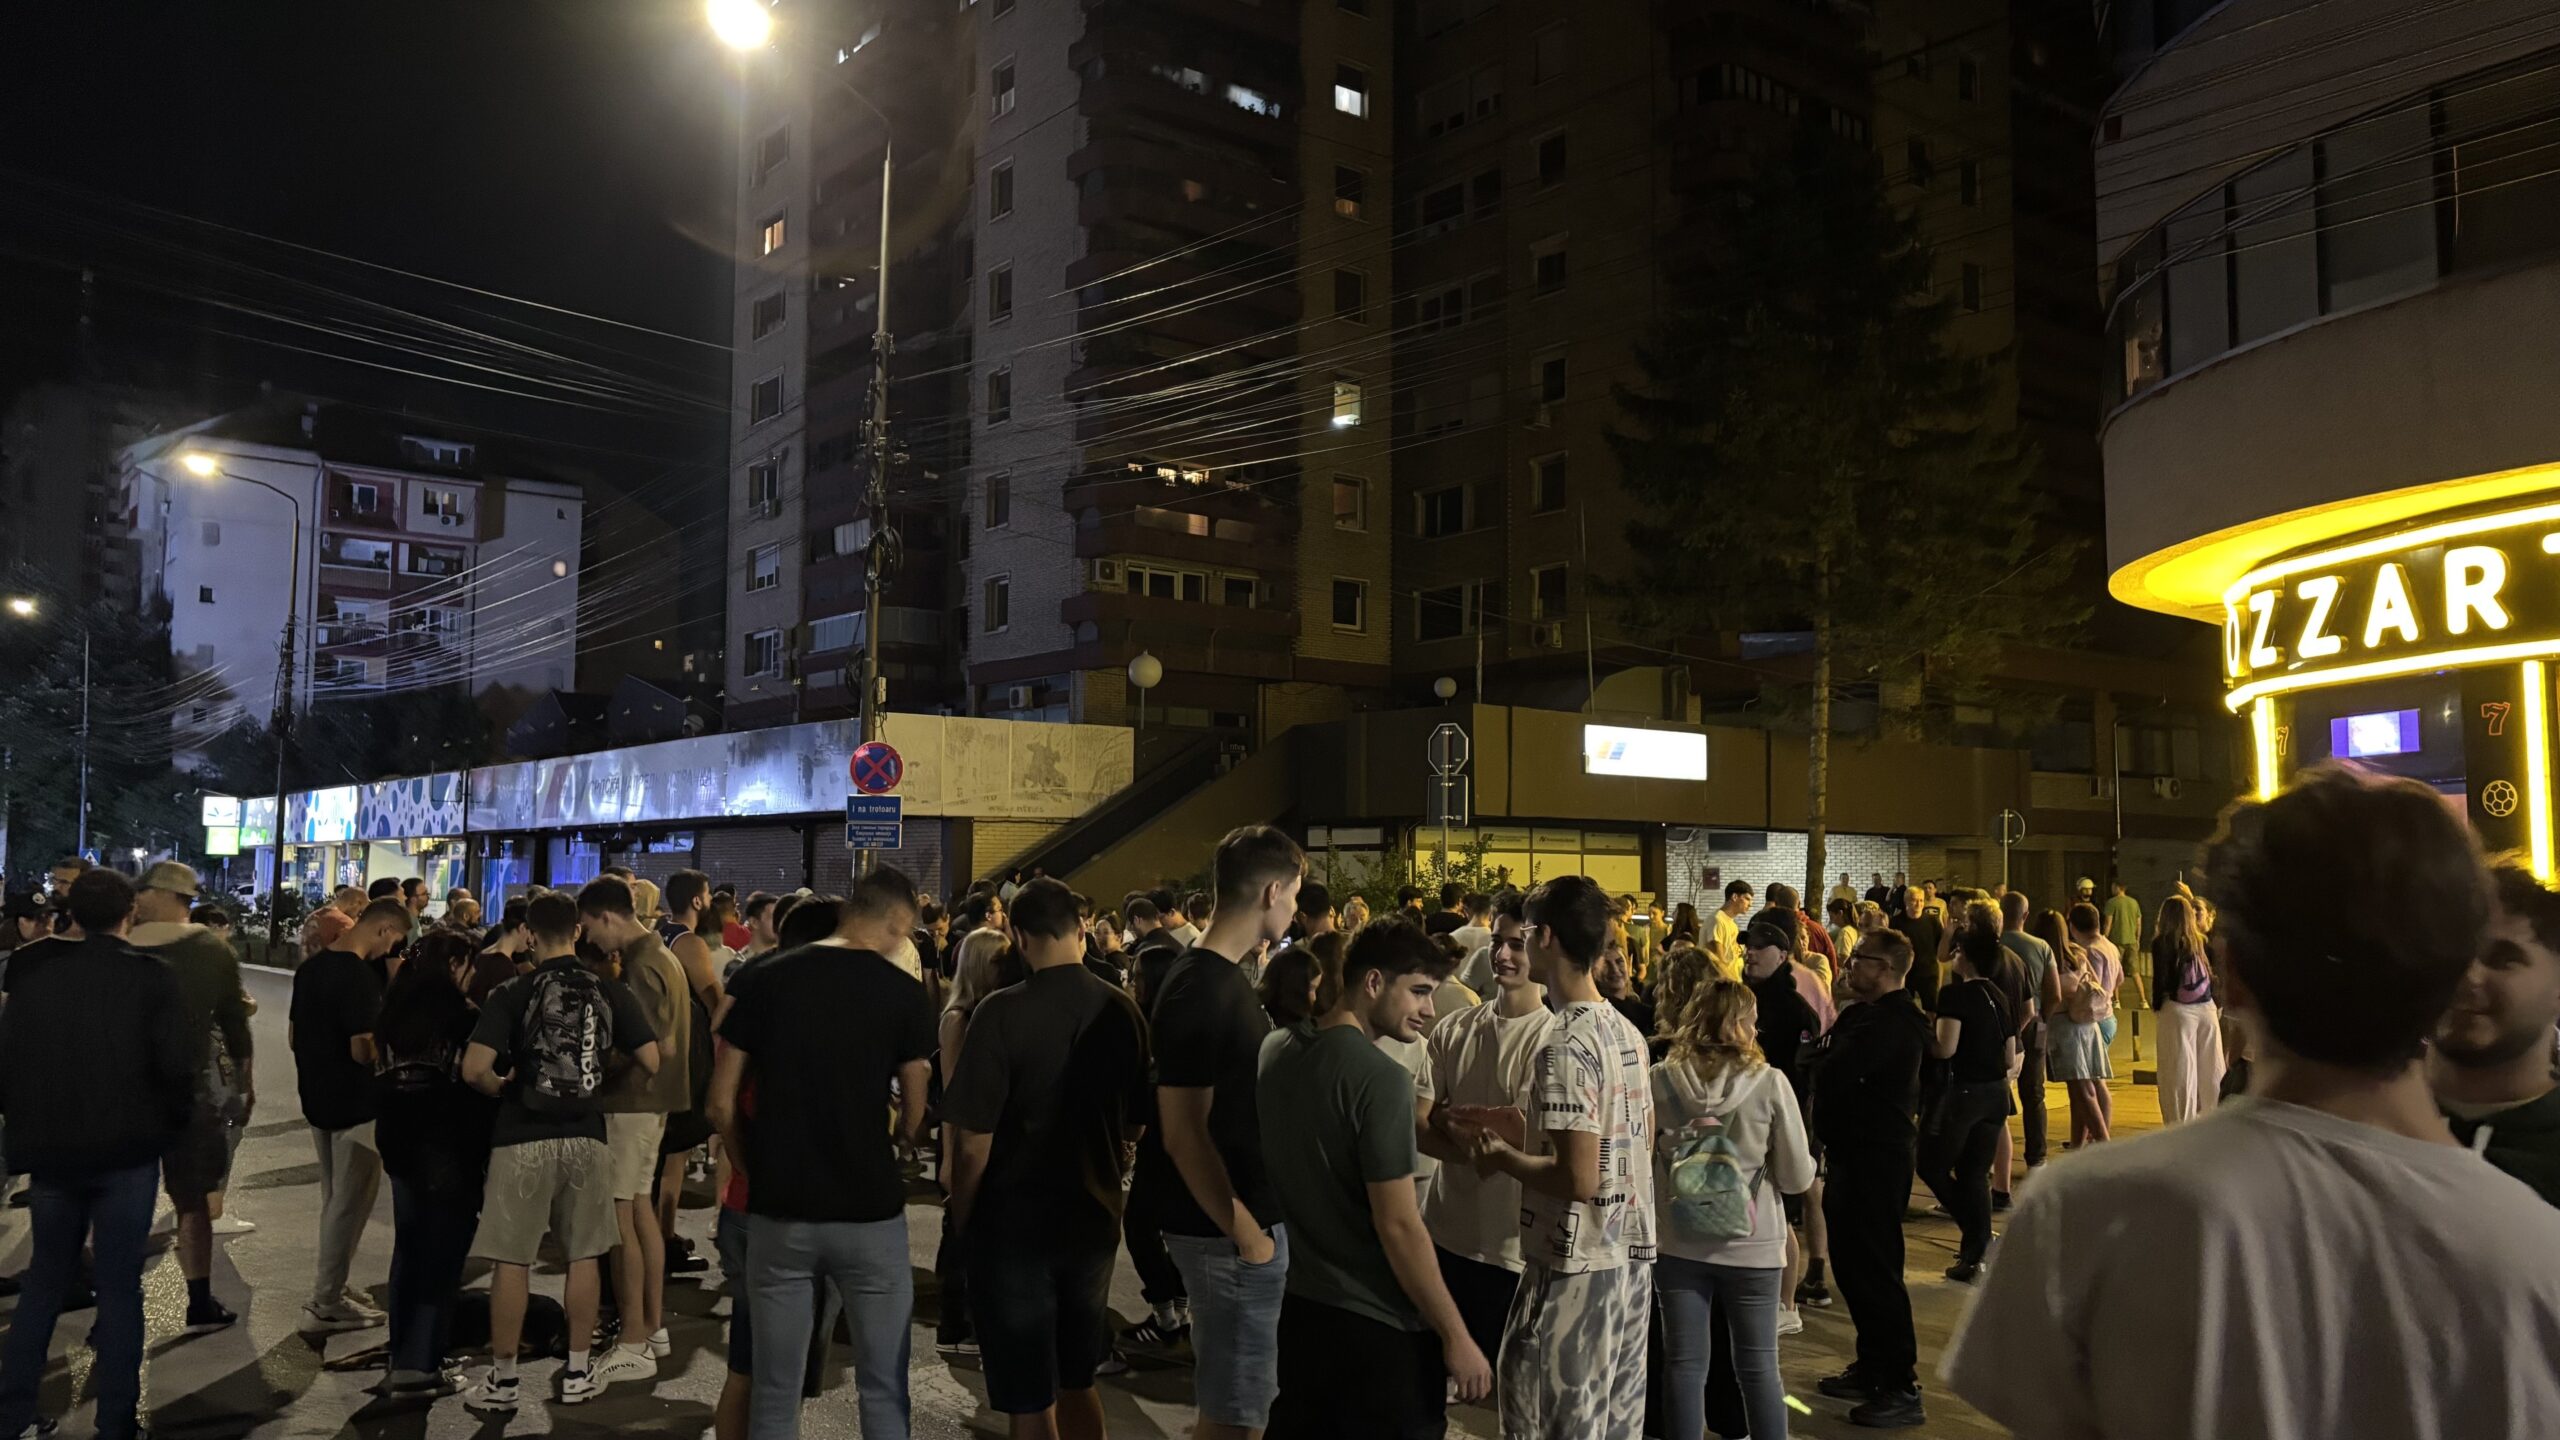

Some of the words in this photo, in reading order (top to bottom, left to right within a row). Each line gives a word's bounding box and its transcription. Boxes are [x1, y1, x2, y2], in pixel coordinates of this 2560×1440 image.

[2224, 534, 2560, 678] OZZAR
[2481, 702, 2510, 735] 7
[869, 804, 896, 814] trotoaru
[581, 1004, 595, 1091] adidas
[1589, 1193, 1626, 1207] UMA
[1630, 1246, 1657, 1260] PUM
